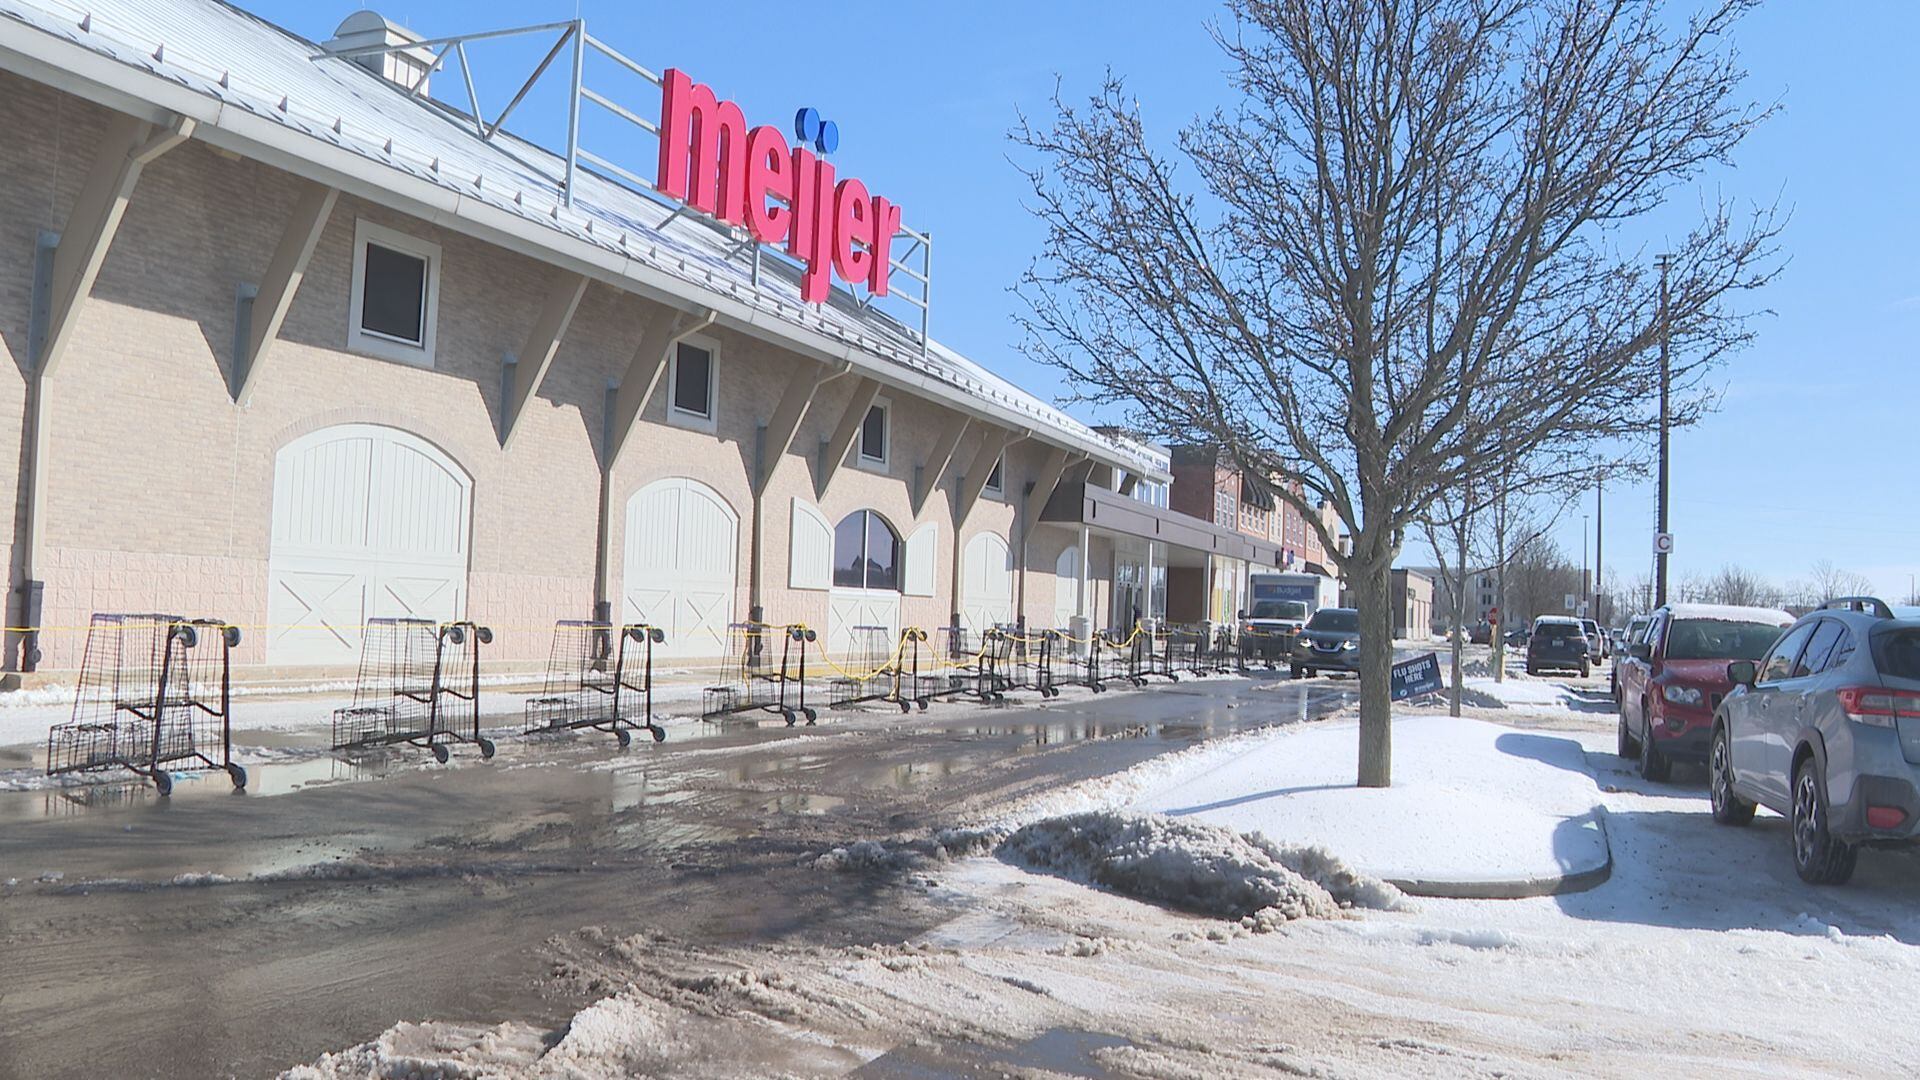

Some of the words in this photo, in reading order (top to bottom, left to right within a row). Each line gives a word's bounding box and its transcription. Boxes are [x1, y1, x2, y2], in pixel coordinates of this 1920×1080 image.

[658, 68, 901, 304] meijer
[1658, 536, 1670, 550] C
[1276, 586, 1302, 596] Budget
[1393, 668, 1407, 679] FLU
[1407, 660, 1431, 673] SHOTS
[1404, 672, 1424, 684] HERE
